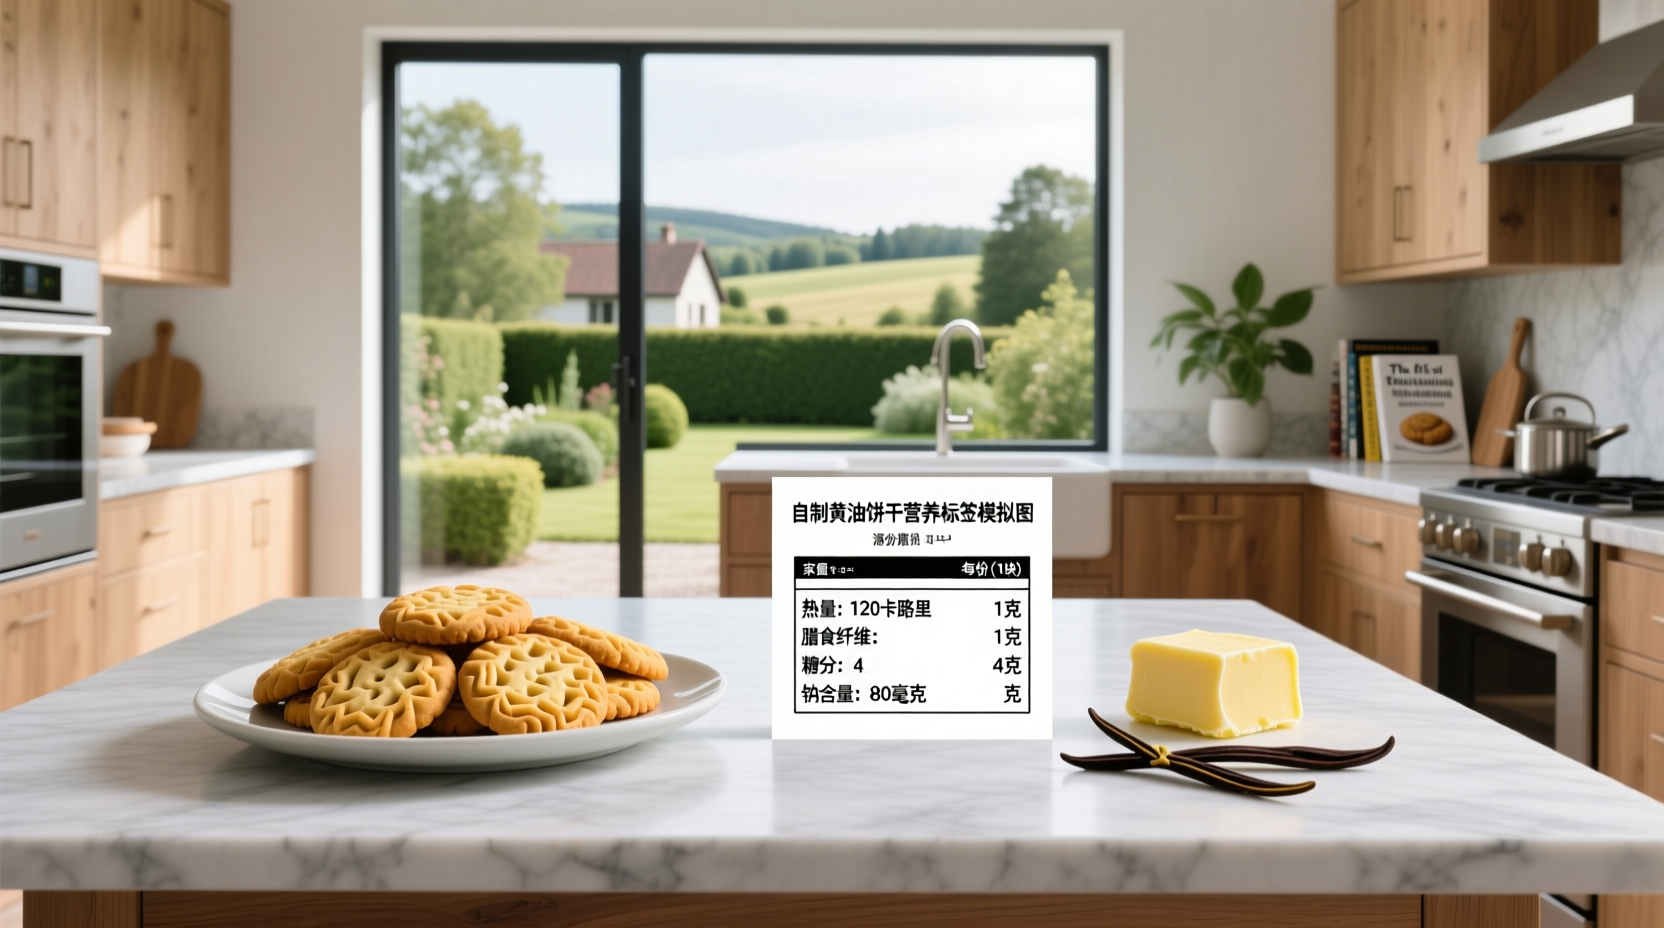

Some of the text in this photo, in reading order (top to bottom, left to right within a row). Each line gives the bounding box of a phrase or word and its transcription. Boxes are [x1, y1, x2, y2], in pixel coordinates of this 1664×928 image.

[792, 501, 1034, 524] 自制黄油饼干营养标签模拟图
[994, 599, 1022, 619] 1克
[994, 626, 1022, 647] 1克
[992, 655, 1022, 675] 4克
[1003, 684, 1022, 704] 克
